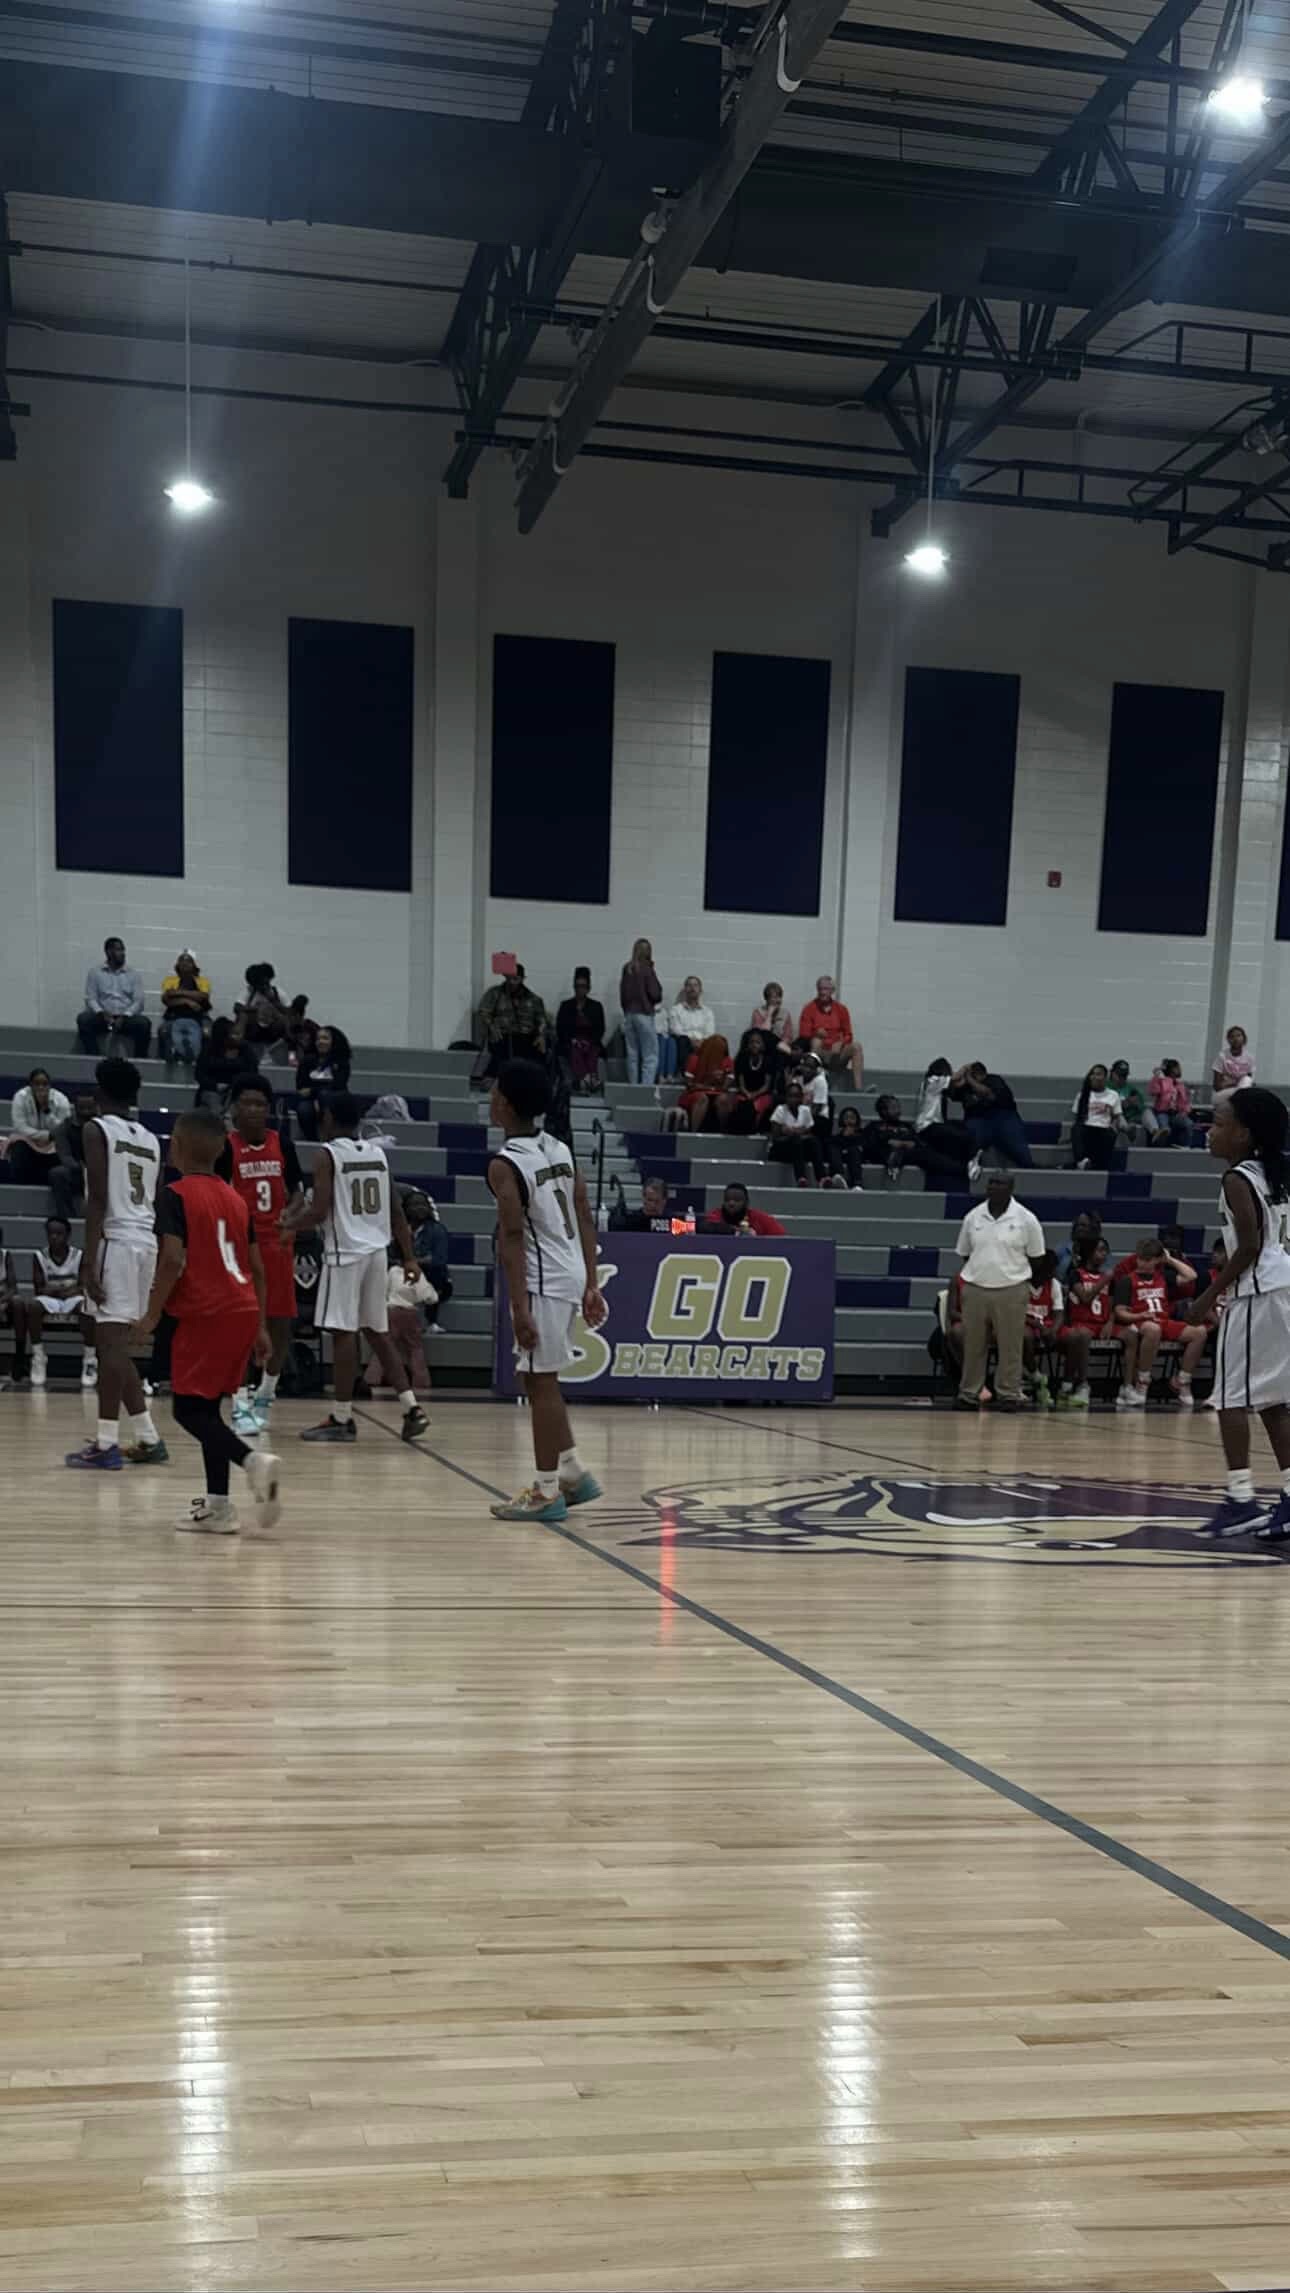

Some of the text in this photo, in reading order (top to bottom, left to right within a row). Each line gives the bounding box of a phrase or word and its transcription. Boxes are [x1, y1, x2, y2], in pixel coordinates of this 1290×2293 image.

[255, 1179, 272, 1212] 3
[351, 1177, 381, 1215] 10
[217, 1218, 248, 1285] 4
[646, 1253, 792, 1343] GO
[1090, 1297, 1102, 1316] 6
[1146, 1298, 1164, 1313] 11
[610, 1342, 826, 1382] BEARCATS
